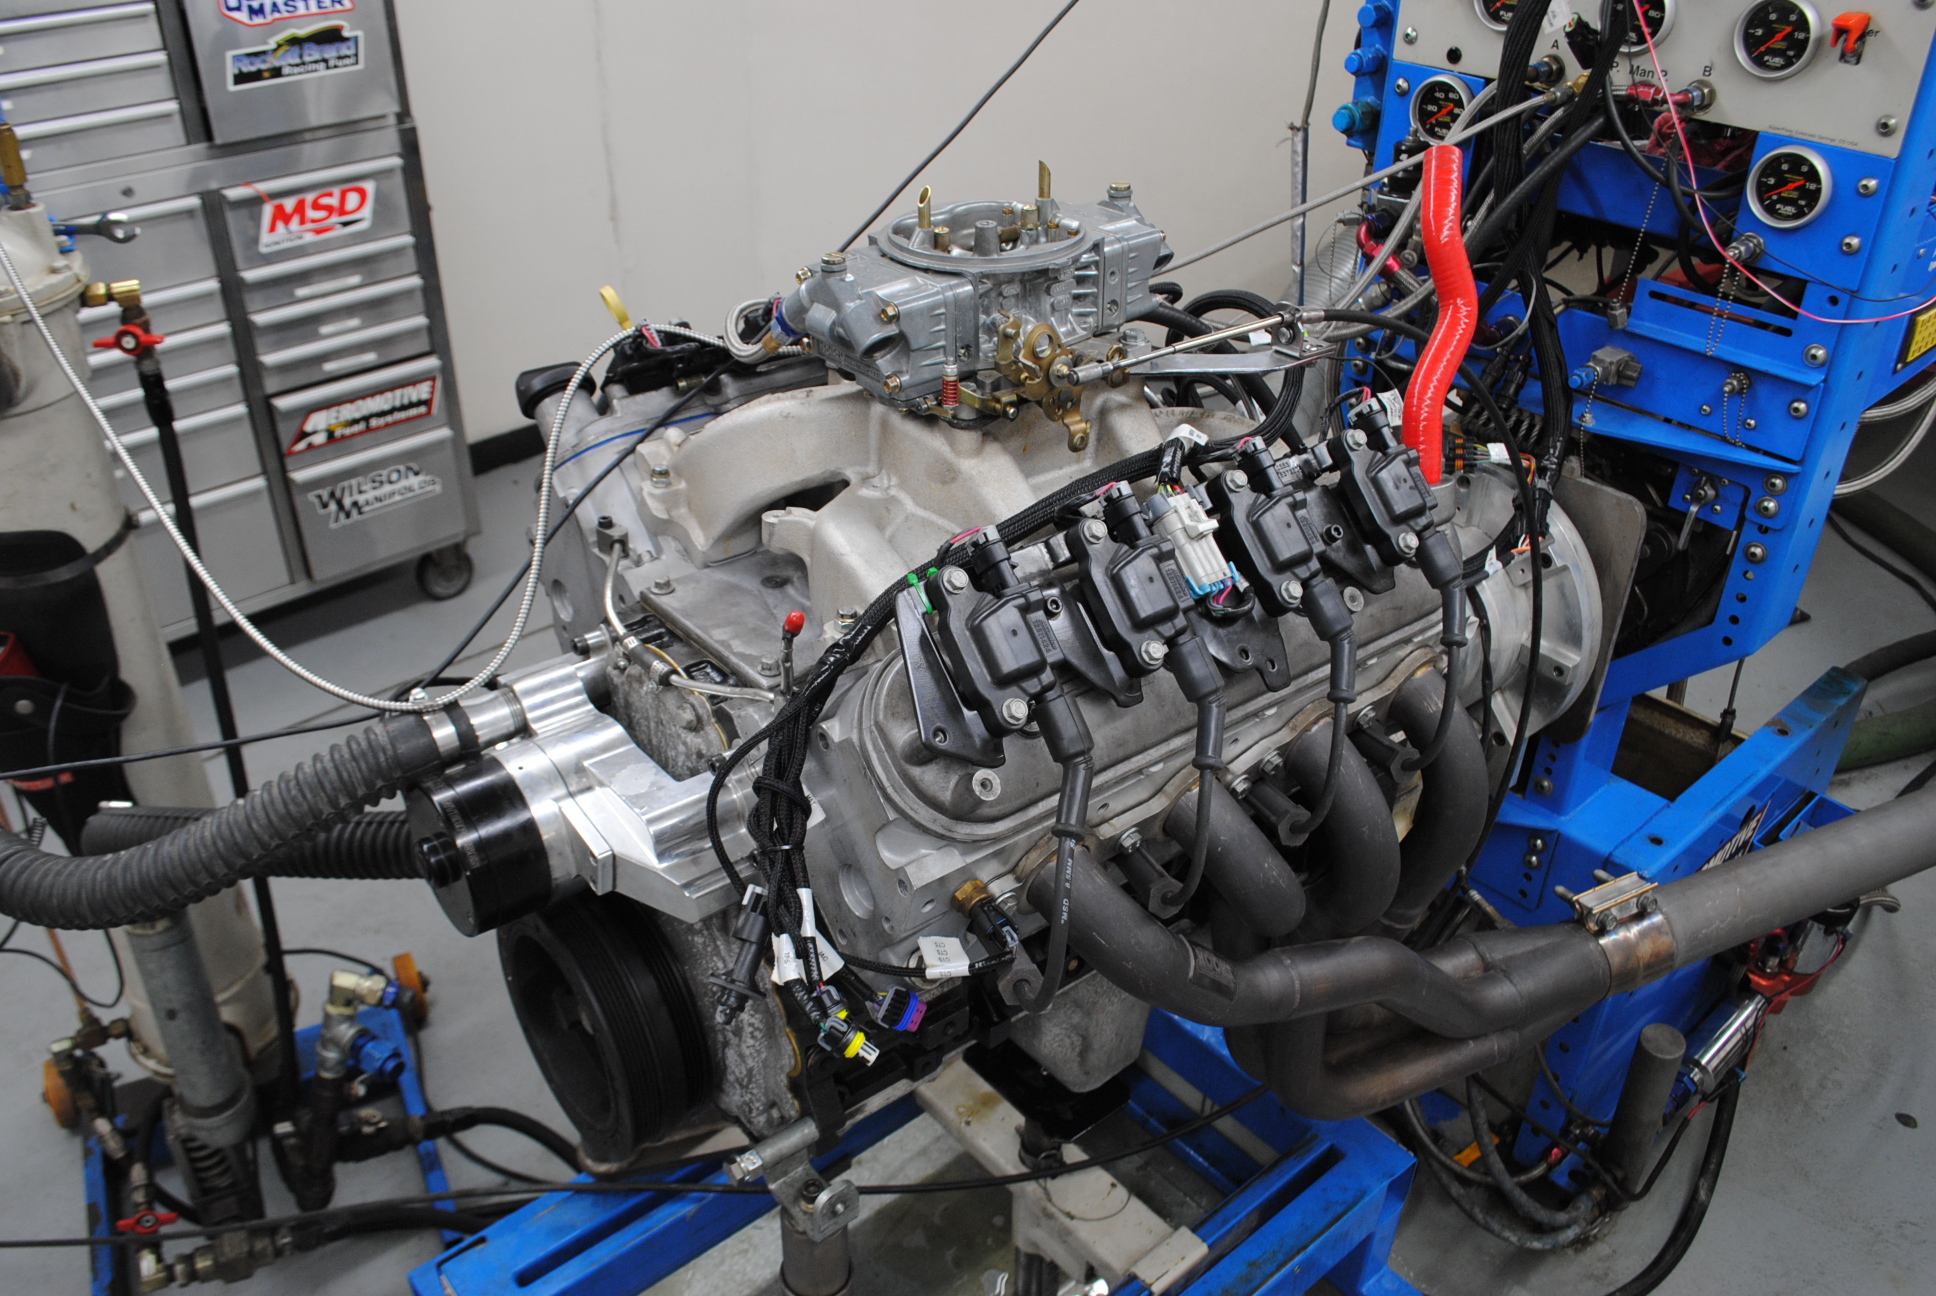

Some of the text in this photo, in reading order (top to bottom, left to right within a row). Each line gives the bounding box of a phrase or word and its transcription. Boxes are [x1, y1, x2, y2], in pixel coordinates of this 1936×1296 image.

[1551, 39, 1559, 50] A
[1764, 56, 1785, 64] FUEL
[281, 61, 327, 76] Racing
[1629, 64, 1654, 79] Man
[1702, 65, 1713, 77] B
[1805, 182, 1816, 190] 12
[268, 185, 368, 234] MSD
[1775, 204, 1797, 213] FUEL
[333, 405, 428, 438] Fuel Systems
[311, 462, 421, 512] WILSON
